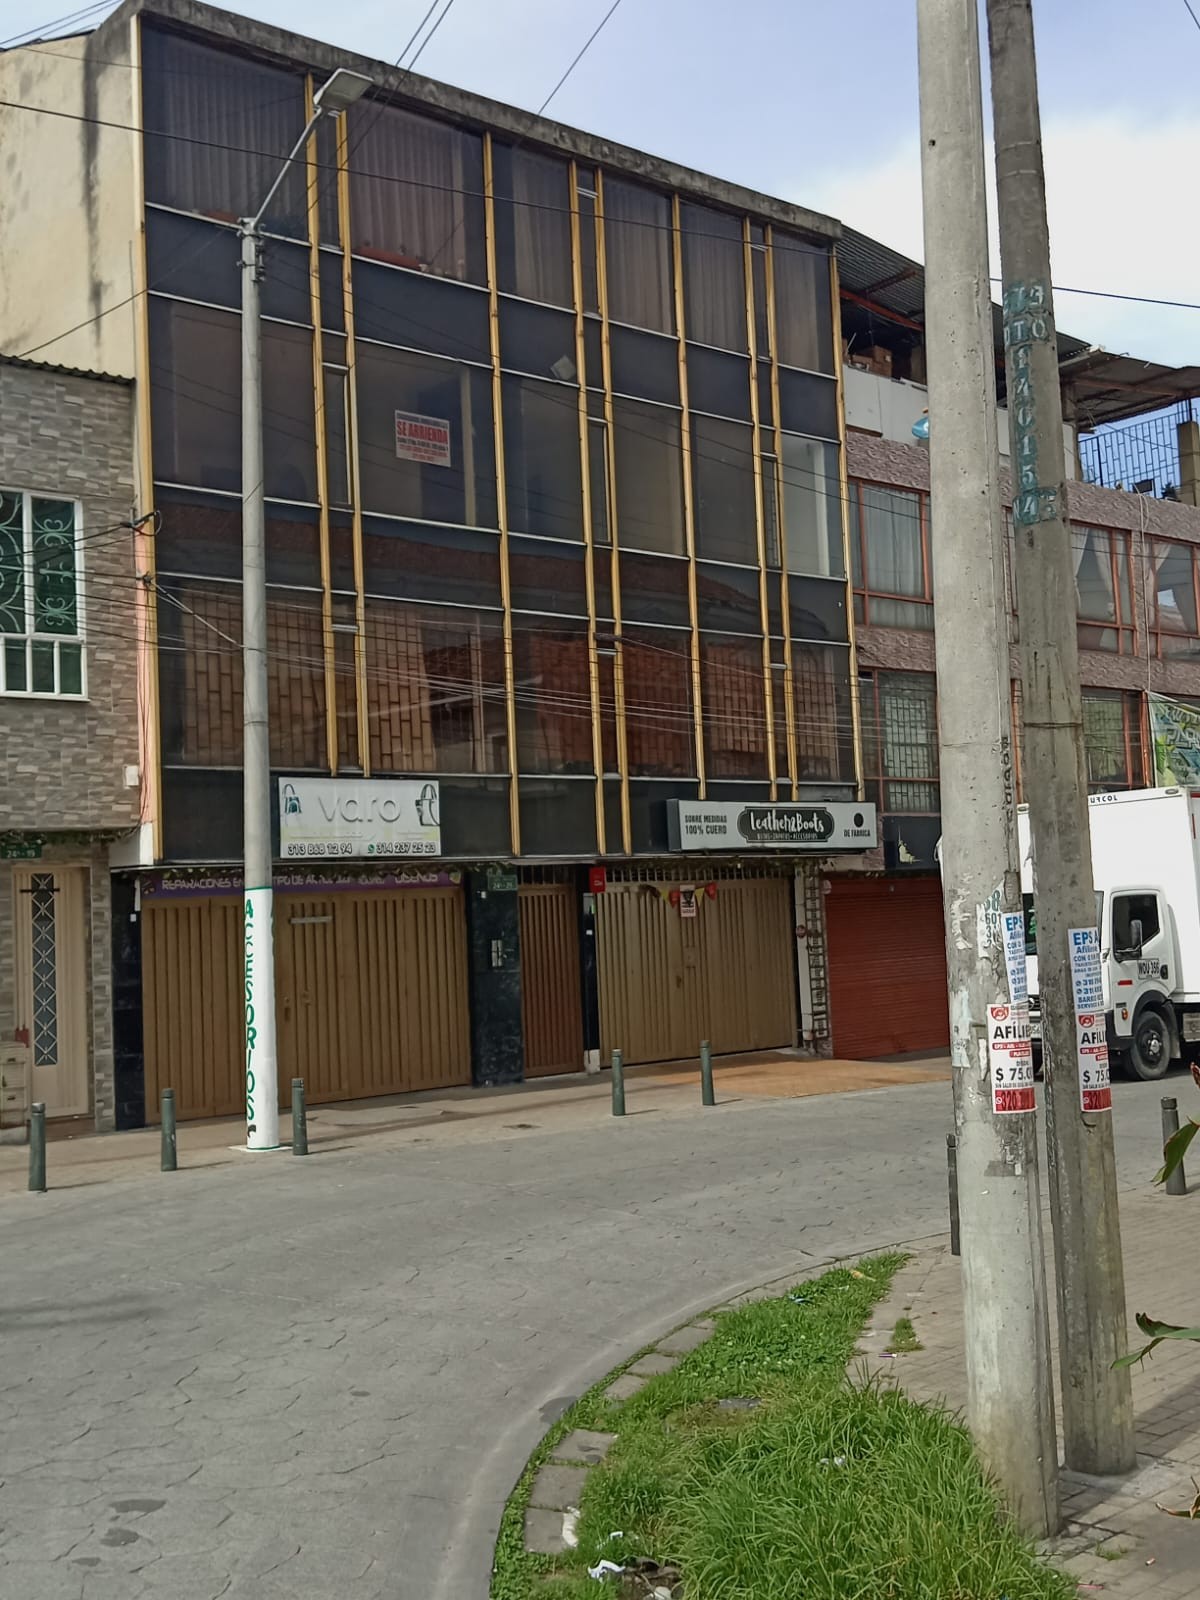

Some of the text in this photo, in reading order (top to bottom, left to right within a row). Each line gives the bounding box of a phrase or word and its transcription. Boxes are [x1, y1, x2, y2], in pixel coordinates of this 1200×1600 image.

[685, 824, 728, 835] 100% CUERO
[287, 843, 306, 856] 313
[161, 878, 231, 890] REPARACIONES
[1073, 931, 1093, 946] EPS
[995, 1067, 1004, 1082] $
